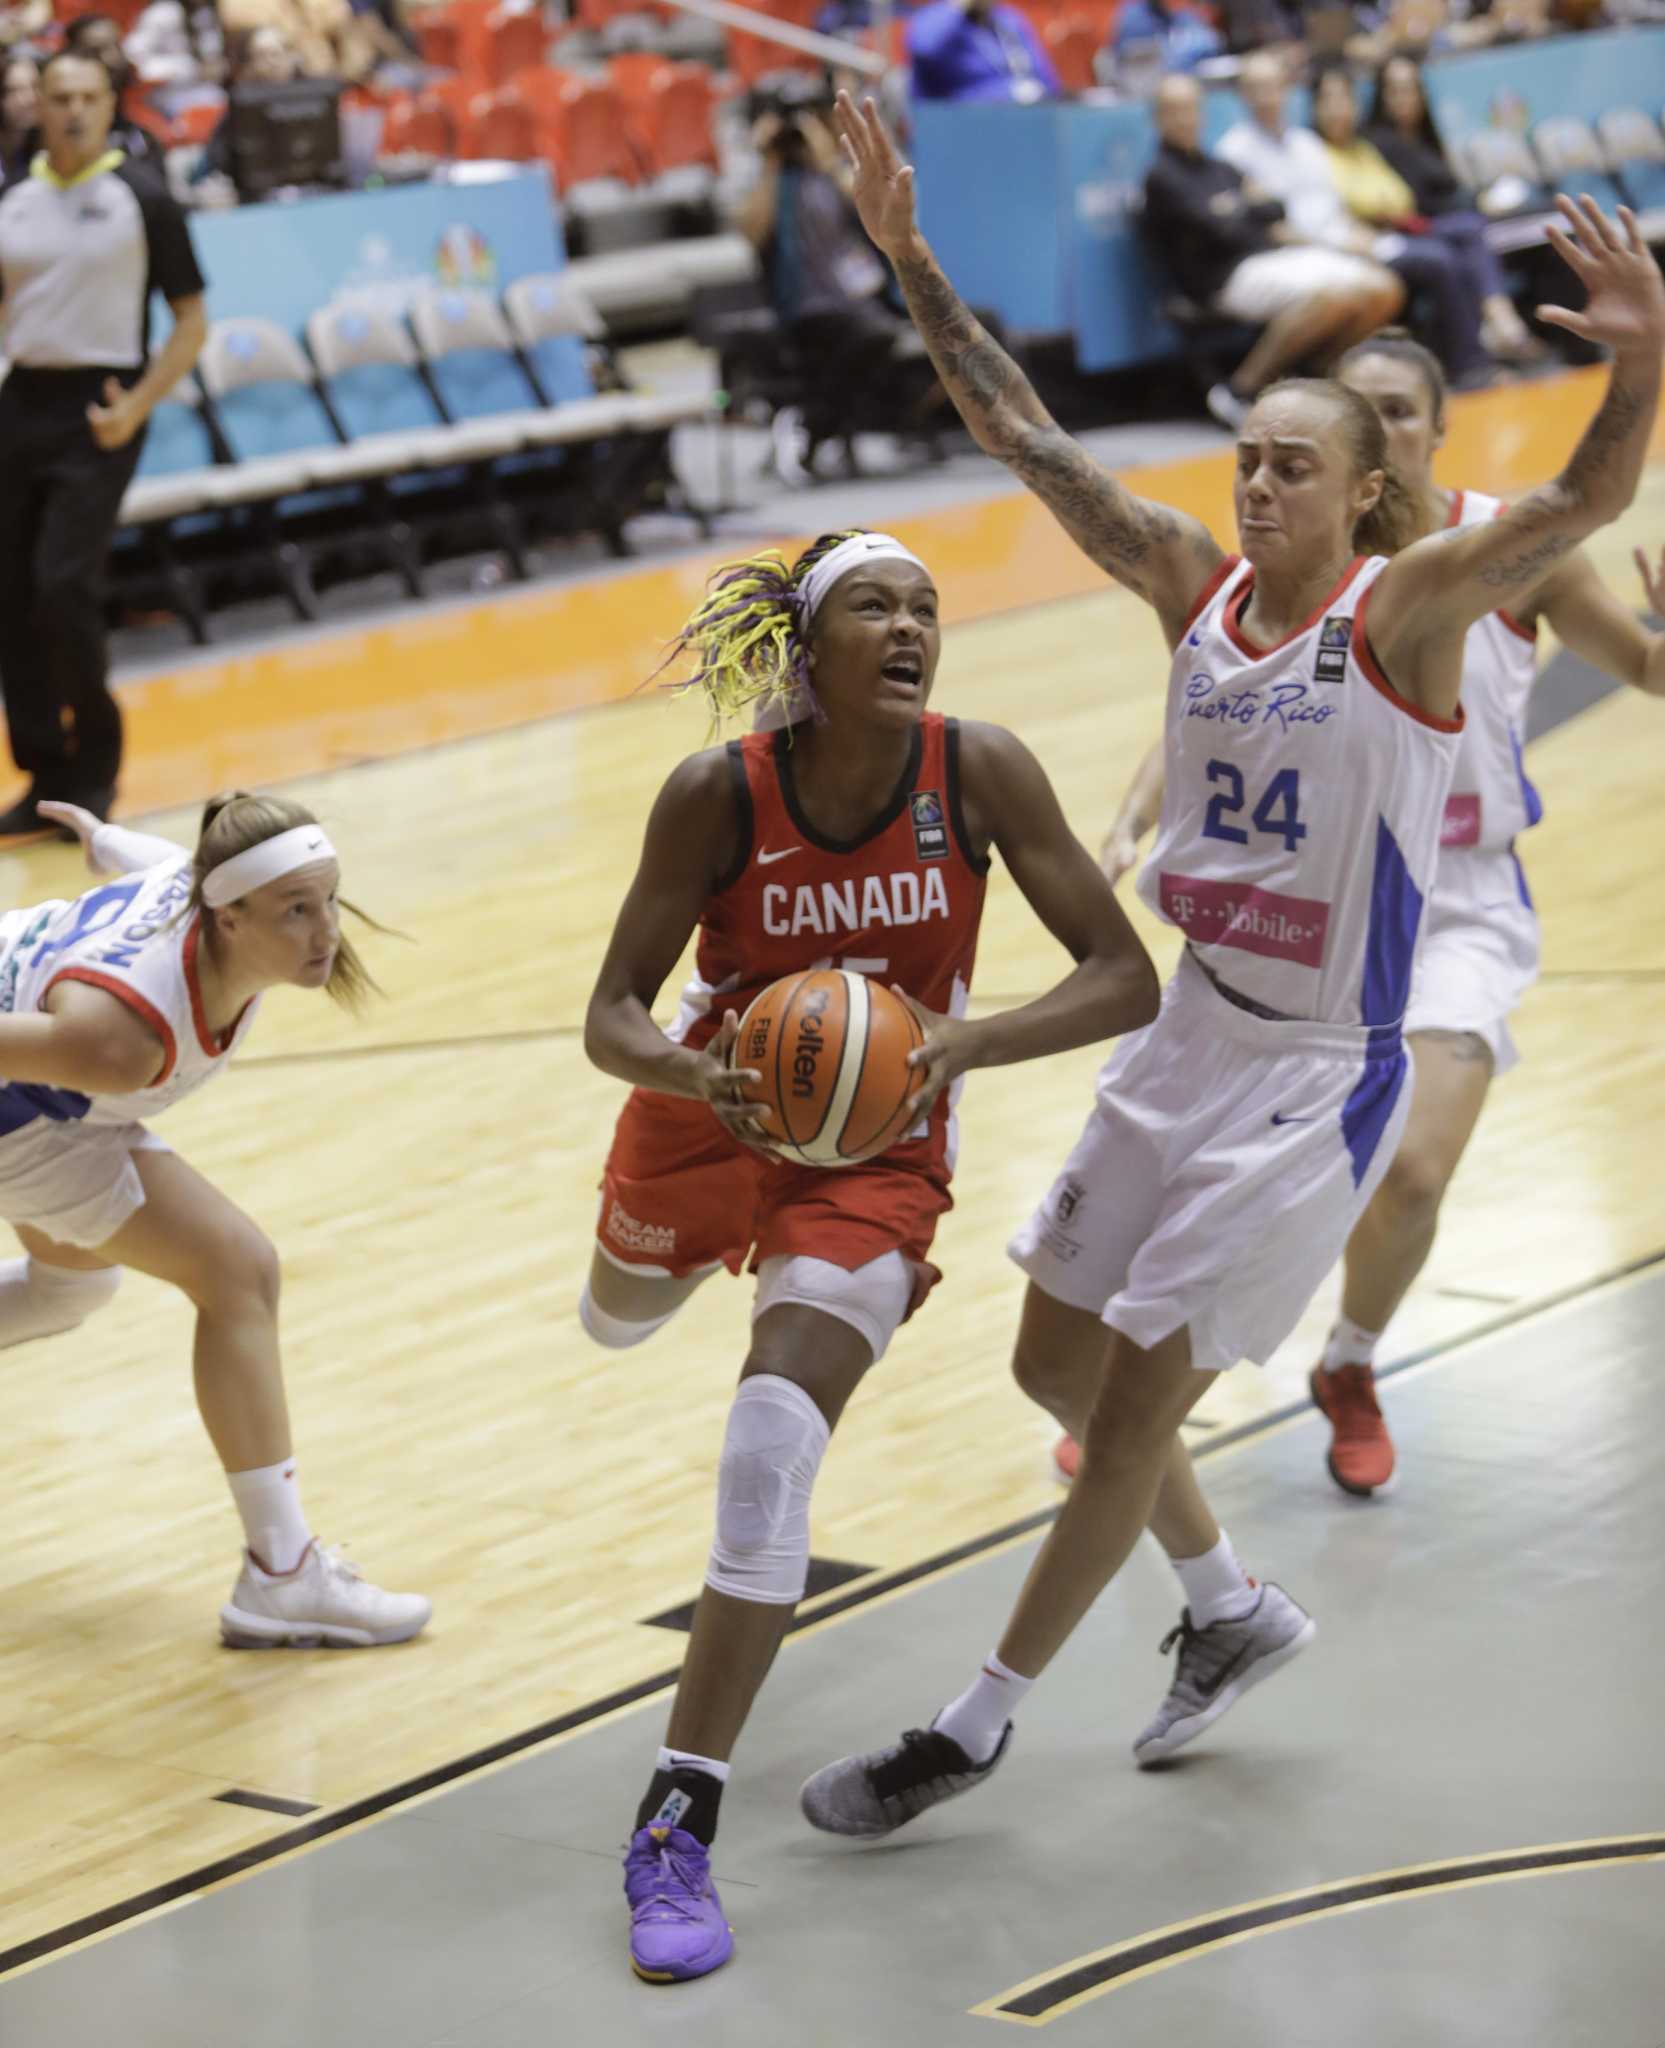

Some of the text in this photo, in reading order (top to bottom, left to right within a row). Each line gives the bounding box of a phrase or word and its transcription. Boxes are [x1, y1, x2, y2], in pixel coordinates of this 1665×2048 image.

[1181, 673, 1334, 734] Puerto Rico
[1202, 758, 1307, 853] 24
[763, 867, 949, 936] CANADA
[751, 1017, 771, 1059] FIBA
[792, 988, 831, 1098] molten
